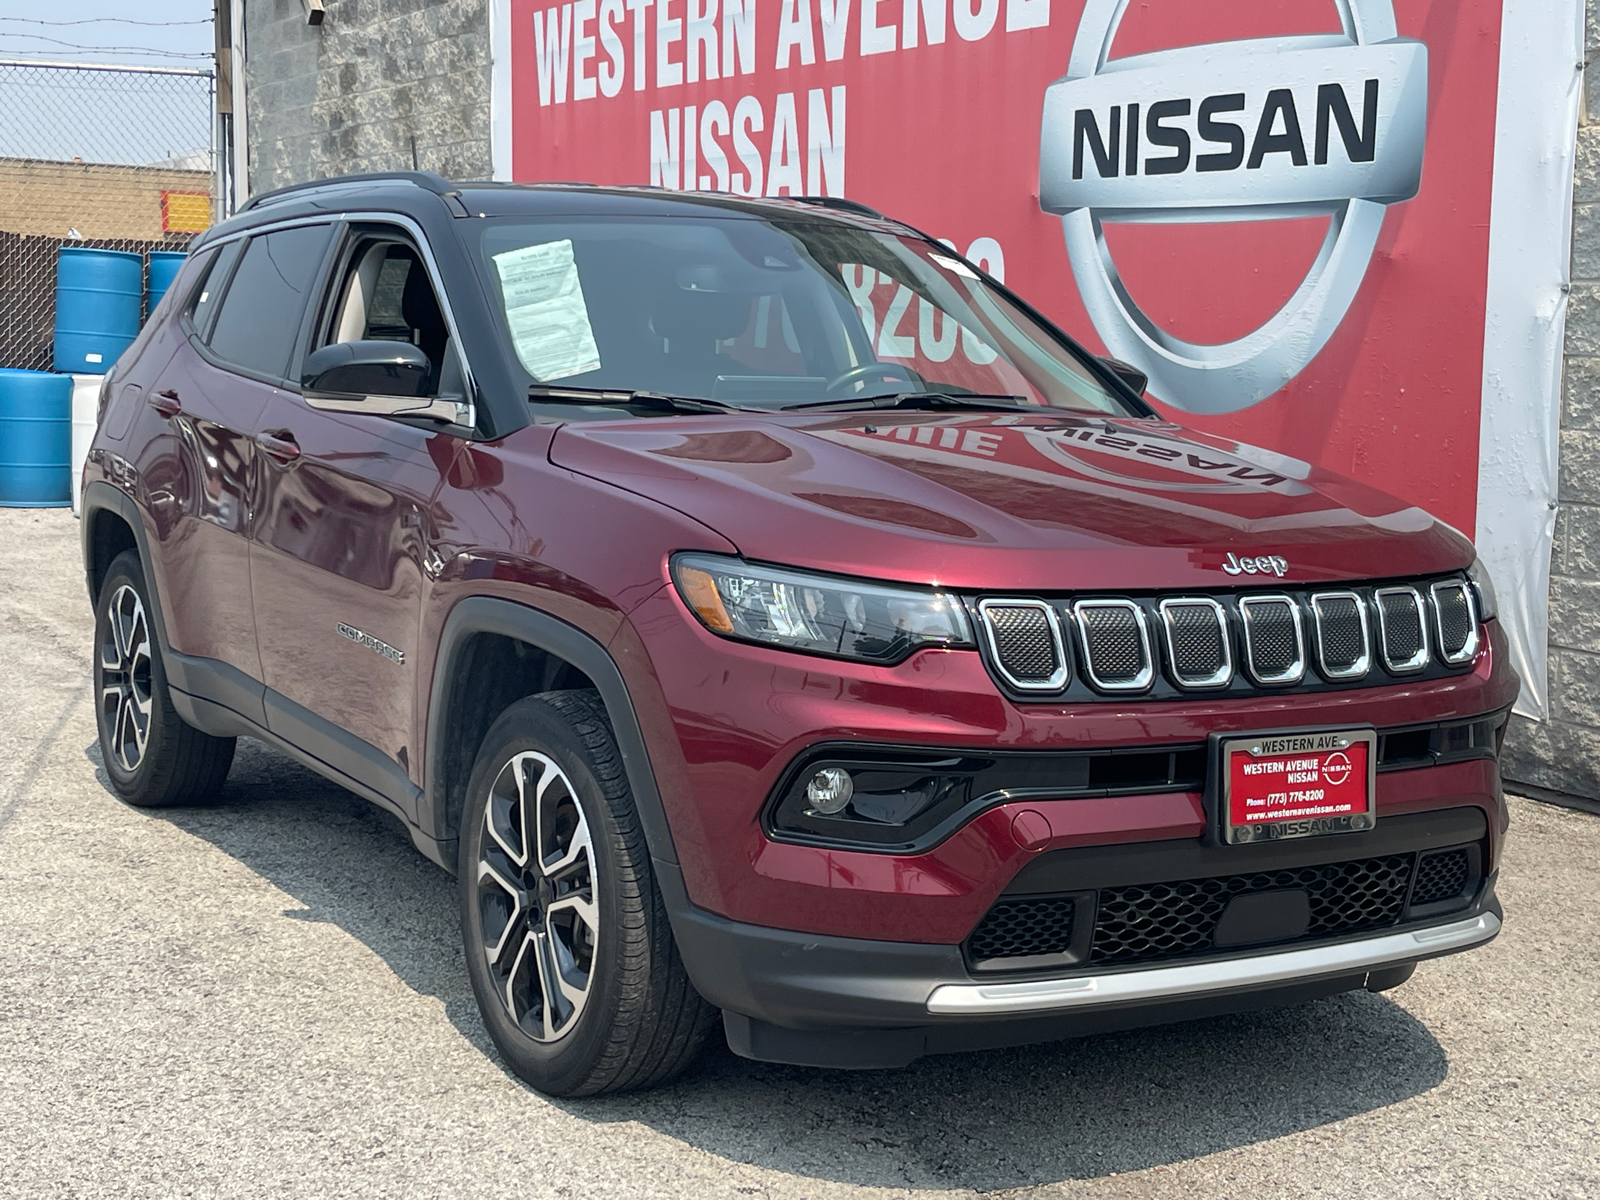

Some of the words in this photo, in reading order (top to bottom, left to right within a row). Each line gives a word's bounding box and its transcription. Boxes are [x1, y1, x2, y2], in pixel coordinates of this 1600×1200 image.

[533, 0, 756, 107] WESTERN
[775, 0, 1050, 70] AVE
[1072, 79, 1379, 180] NISSAN
[650, 85, 846, 198] NISSAN
[1221, 551, 1289, 577] Jeep
[335, 621, 406, 666] COMPASS
[1262, 738, 1314, 753] WESTERN
[1243, 762, 1284, 775] WESTERN
[1286, 759, 1319, 772] AVENUE
[1322, 764, 1352, 773] NISSAN
[1287, 771, 1319, 784] NISSAN
[1267, 793, 1287, 807] (773)
[1289, 789, 1325, 803] 776-8200
[1246, 804, 1351, 820] www.westernavenissan.com
[1270, 818, 1334, 838] NISSAN
